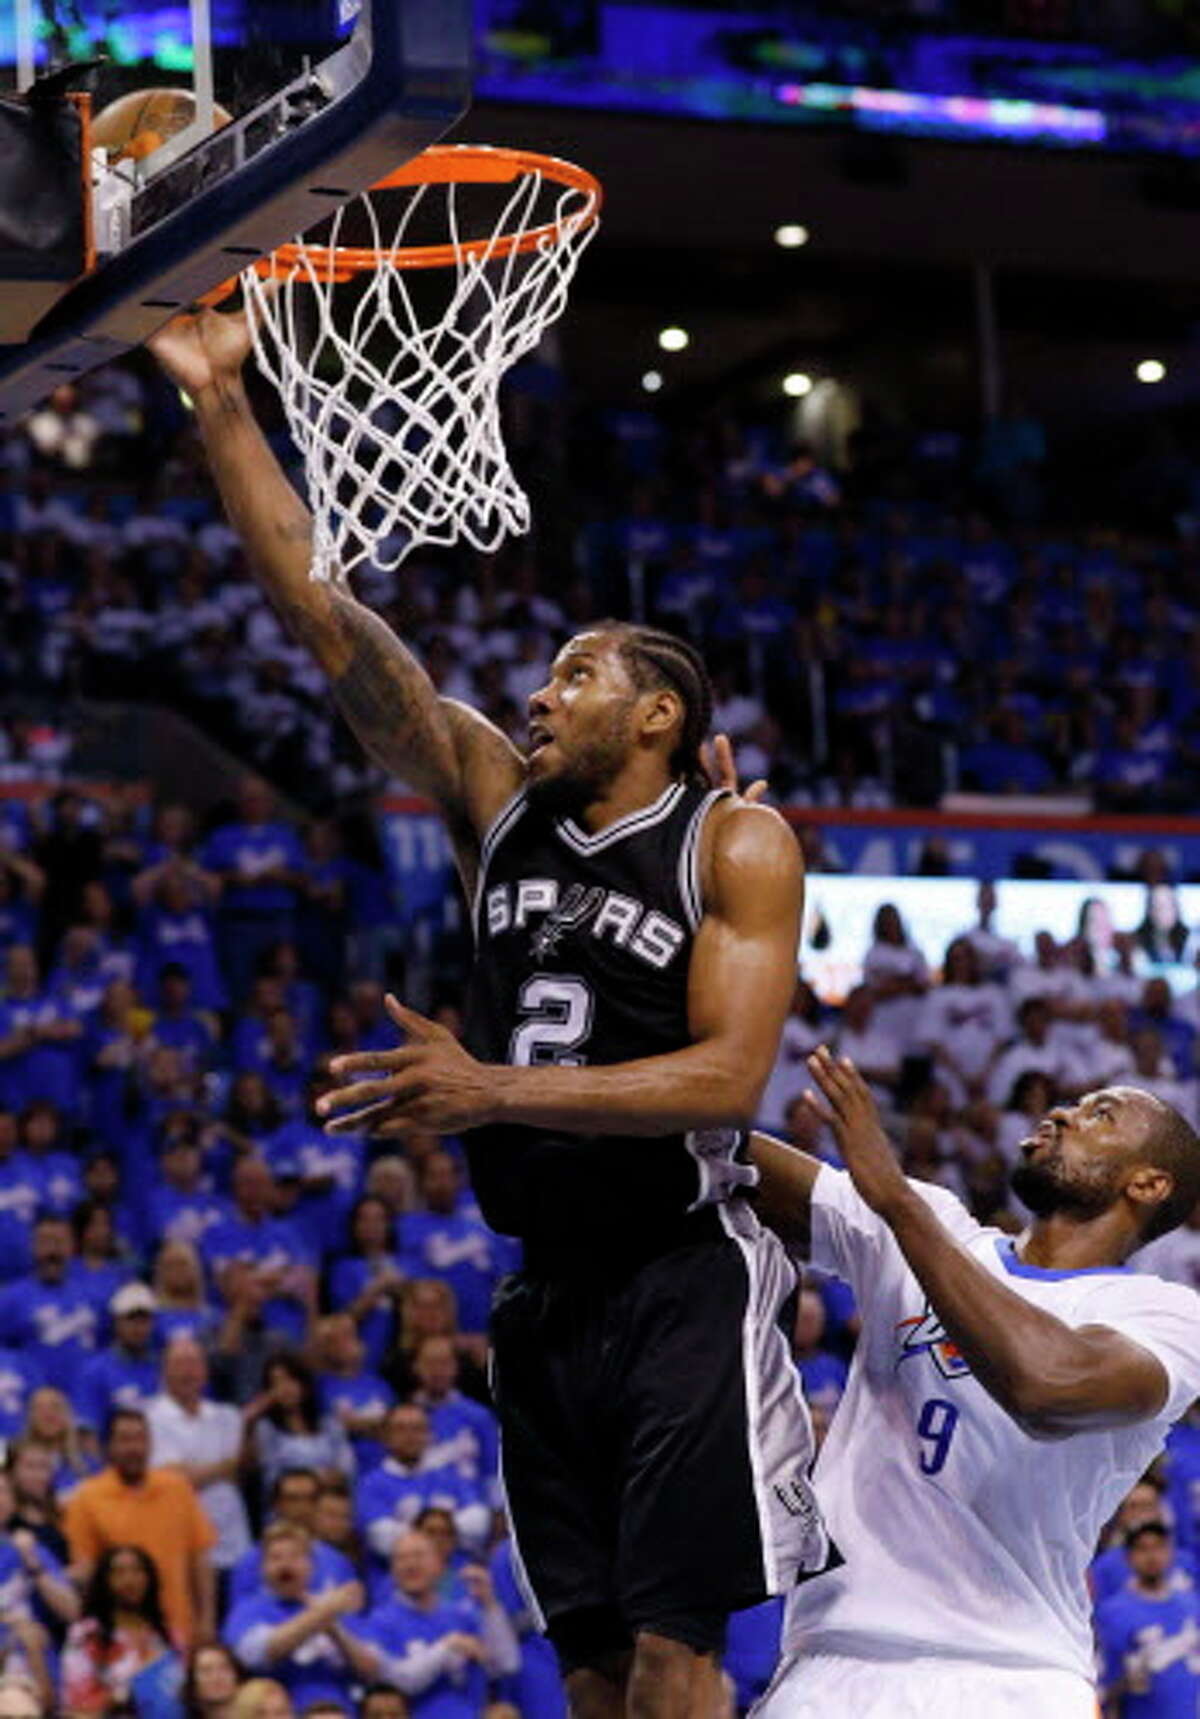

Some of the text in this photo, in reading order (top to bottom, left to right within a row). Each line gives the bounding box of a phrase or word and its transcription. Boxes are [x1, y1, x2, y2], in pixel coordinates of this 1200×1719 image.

[486, 878, 686, 969] SPURS
[508, 972, 596, 1066] 2
[918, 1398, 959, 1476] 9
